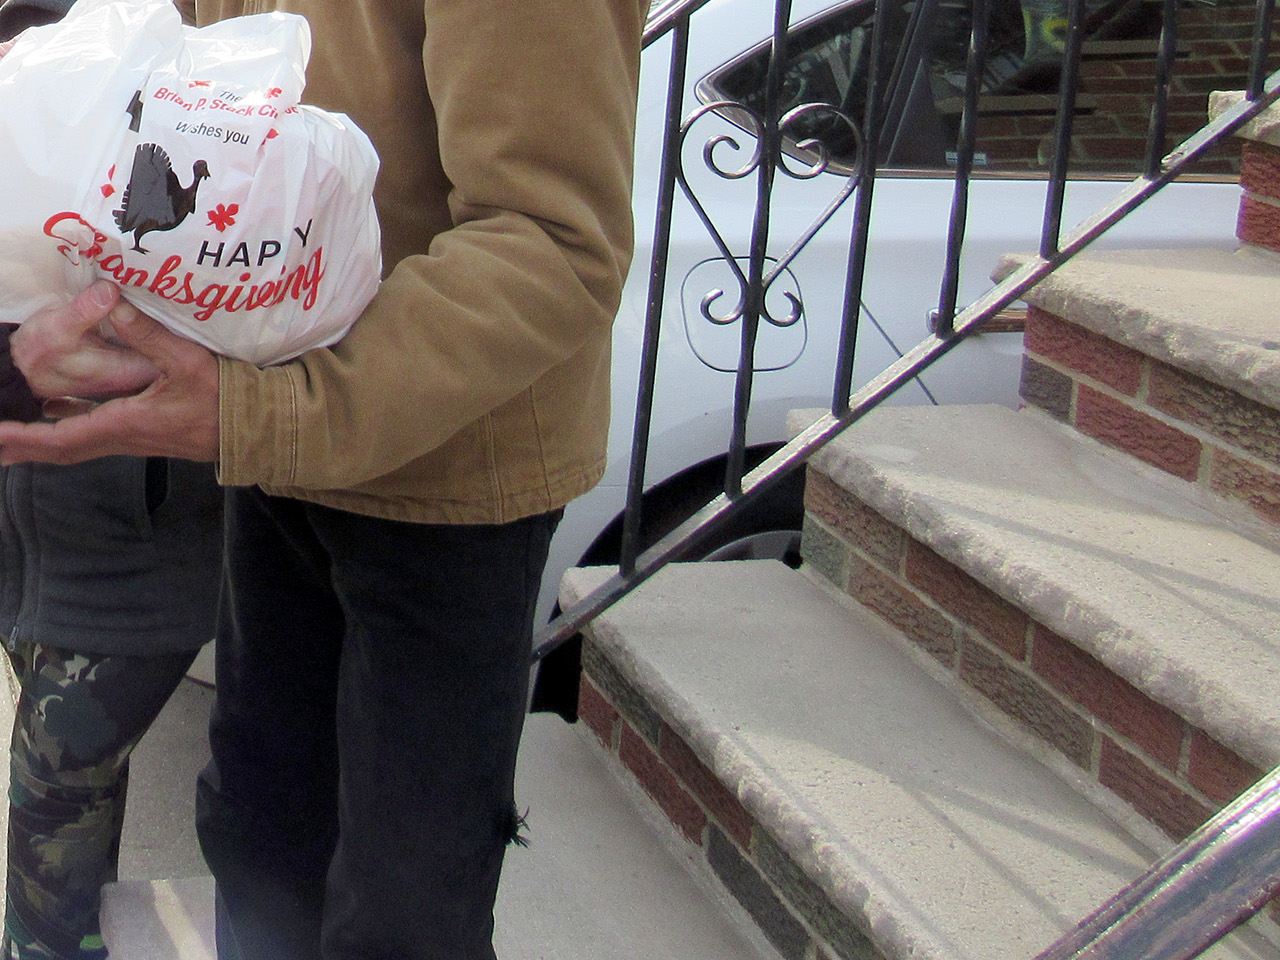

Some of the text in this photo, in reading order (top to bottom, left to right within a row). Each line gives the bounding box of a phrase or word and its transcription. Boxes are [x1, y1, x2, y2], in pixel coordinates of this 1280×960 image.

[153, 87, 194, 111] Brian
[194, 98, 207, 111] P.
[220, 90, 244, 103] The
[222, 129, 250, 145] you
[196, 218, 313, 268] HAPY
